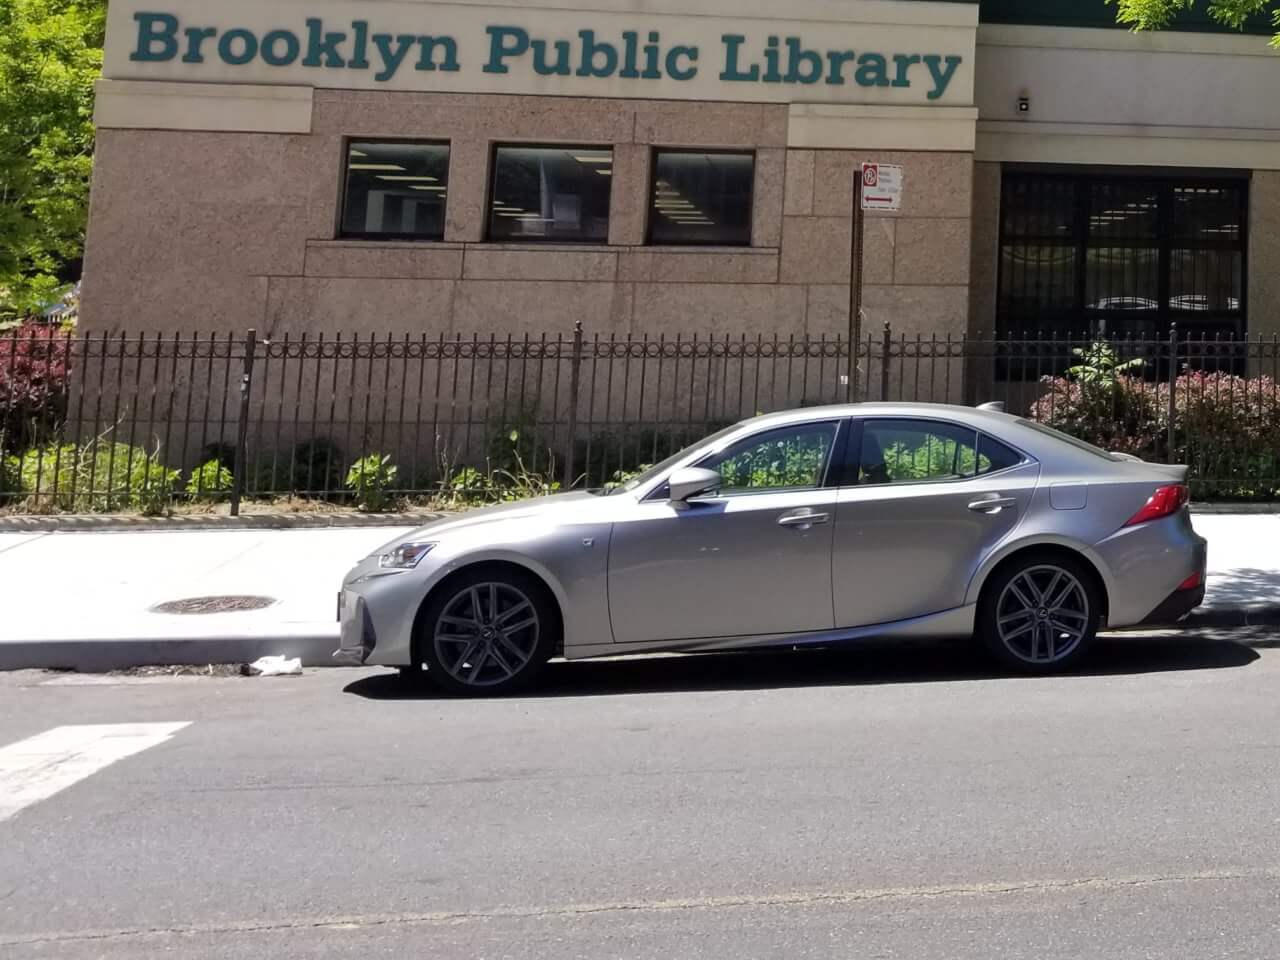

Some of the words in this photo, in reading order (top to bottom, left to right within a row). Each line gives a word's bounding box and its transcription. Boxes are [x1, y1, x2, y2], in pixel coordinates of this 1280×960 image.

[130, 12, 461, 82] Brooklyn
[483, 25, 699, 81] Public
[719, 34, 963, 100] Library
